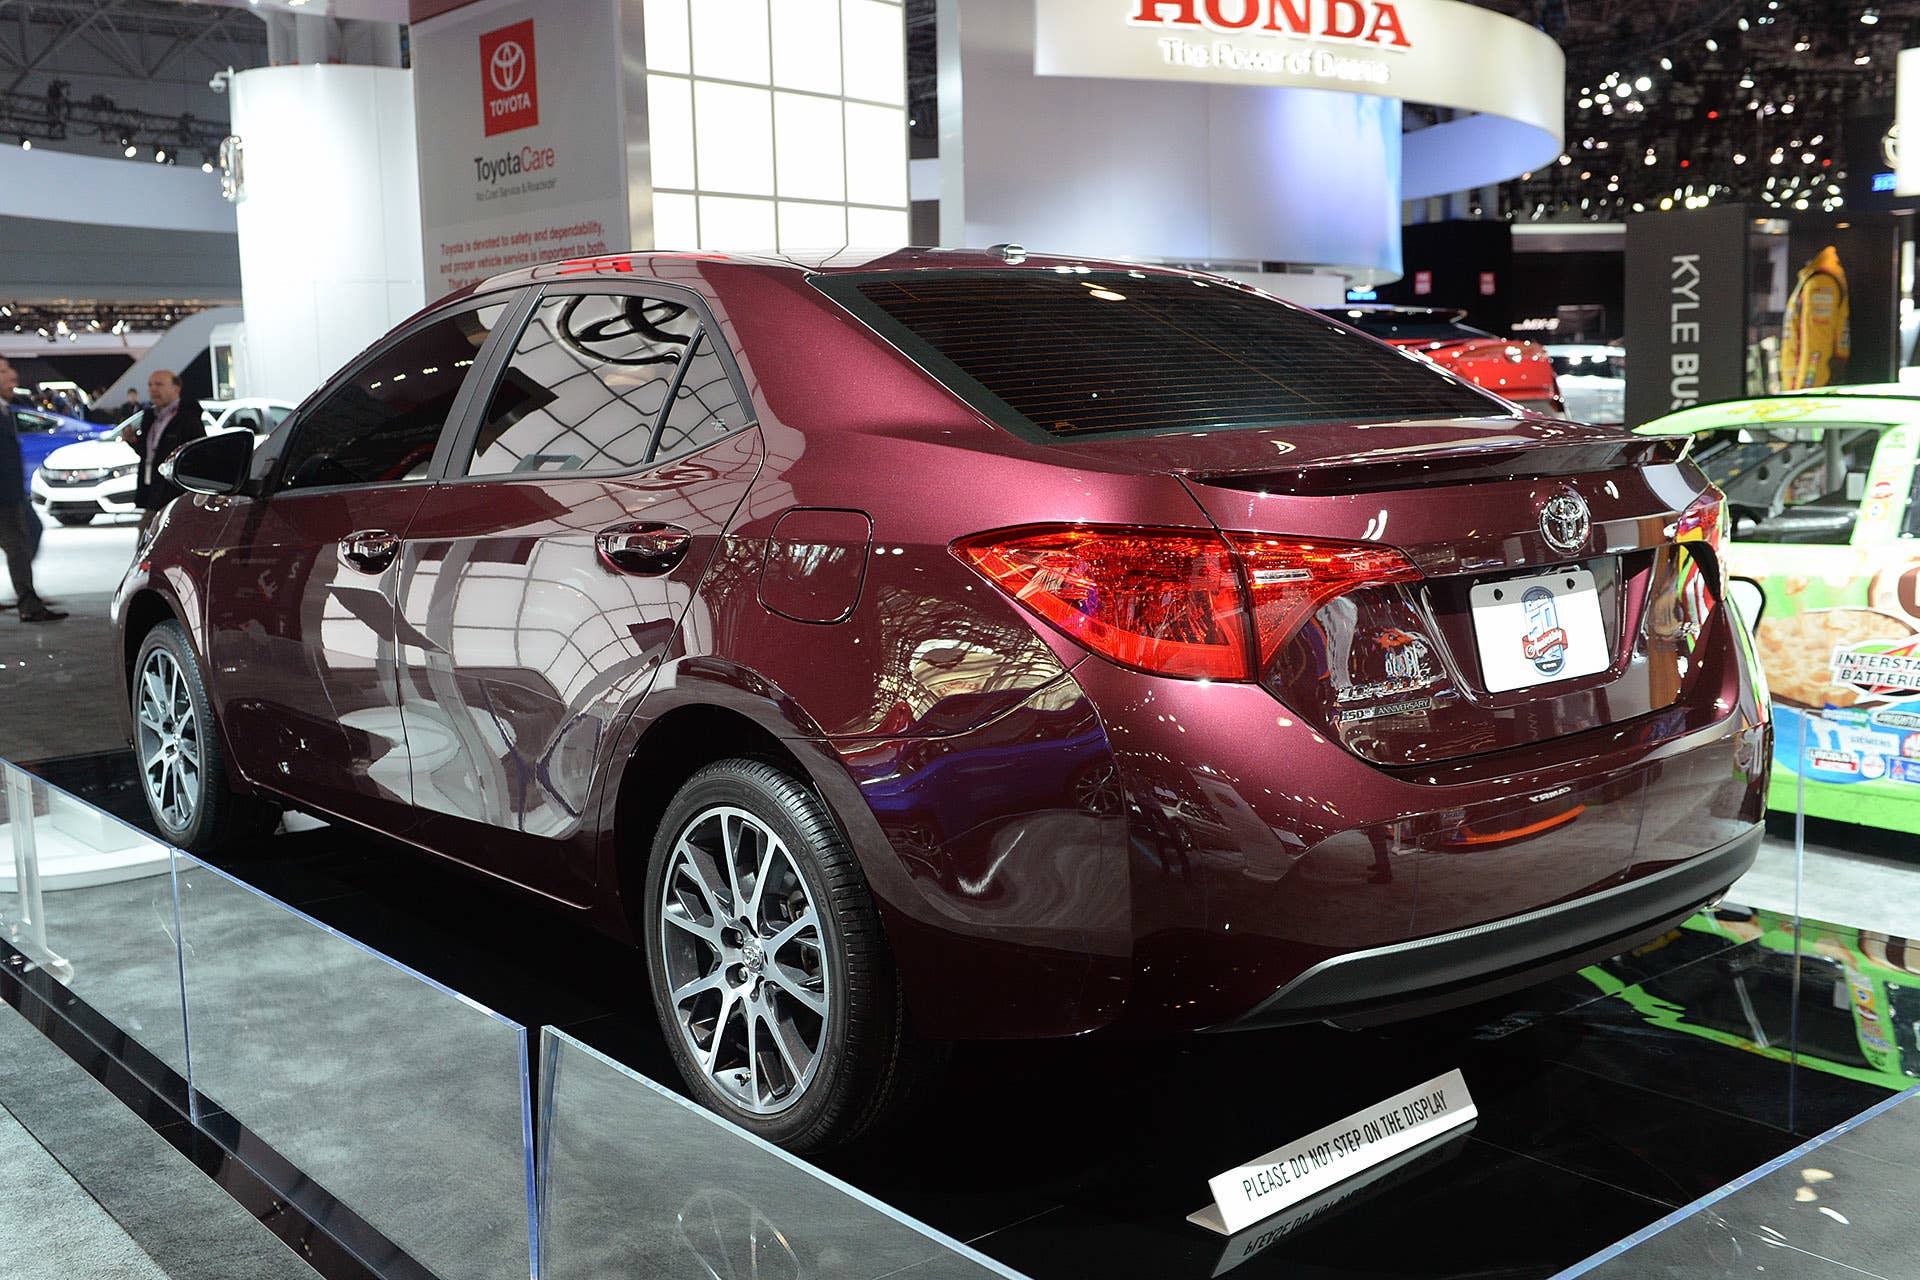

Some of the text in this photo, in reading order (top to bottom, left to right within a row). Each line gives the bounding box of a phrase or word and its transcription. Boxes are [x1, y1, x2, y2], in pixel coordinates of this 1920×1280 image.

[1133, 0, 1411, 47] HONDA
[489, 92, 531, 117] TOYOTA
[474, 146, 555, 184] ToyotaCare
[441, 244, 464, 258] Toyota
[534, 227, 547, 241] and
[440, 262, 452, 273] and
[1671, 254, 1700, 344] KYLE
[1377, 699, 1429, 715] ANNIVERSARY
[1243, 1090, 1448, 1201] PLEASE DO NOT STEP ON THE DISPLAY
